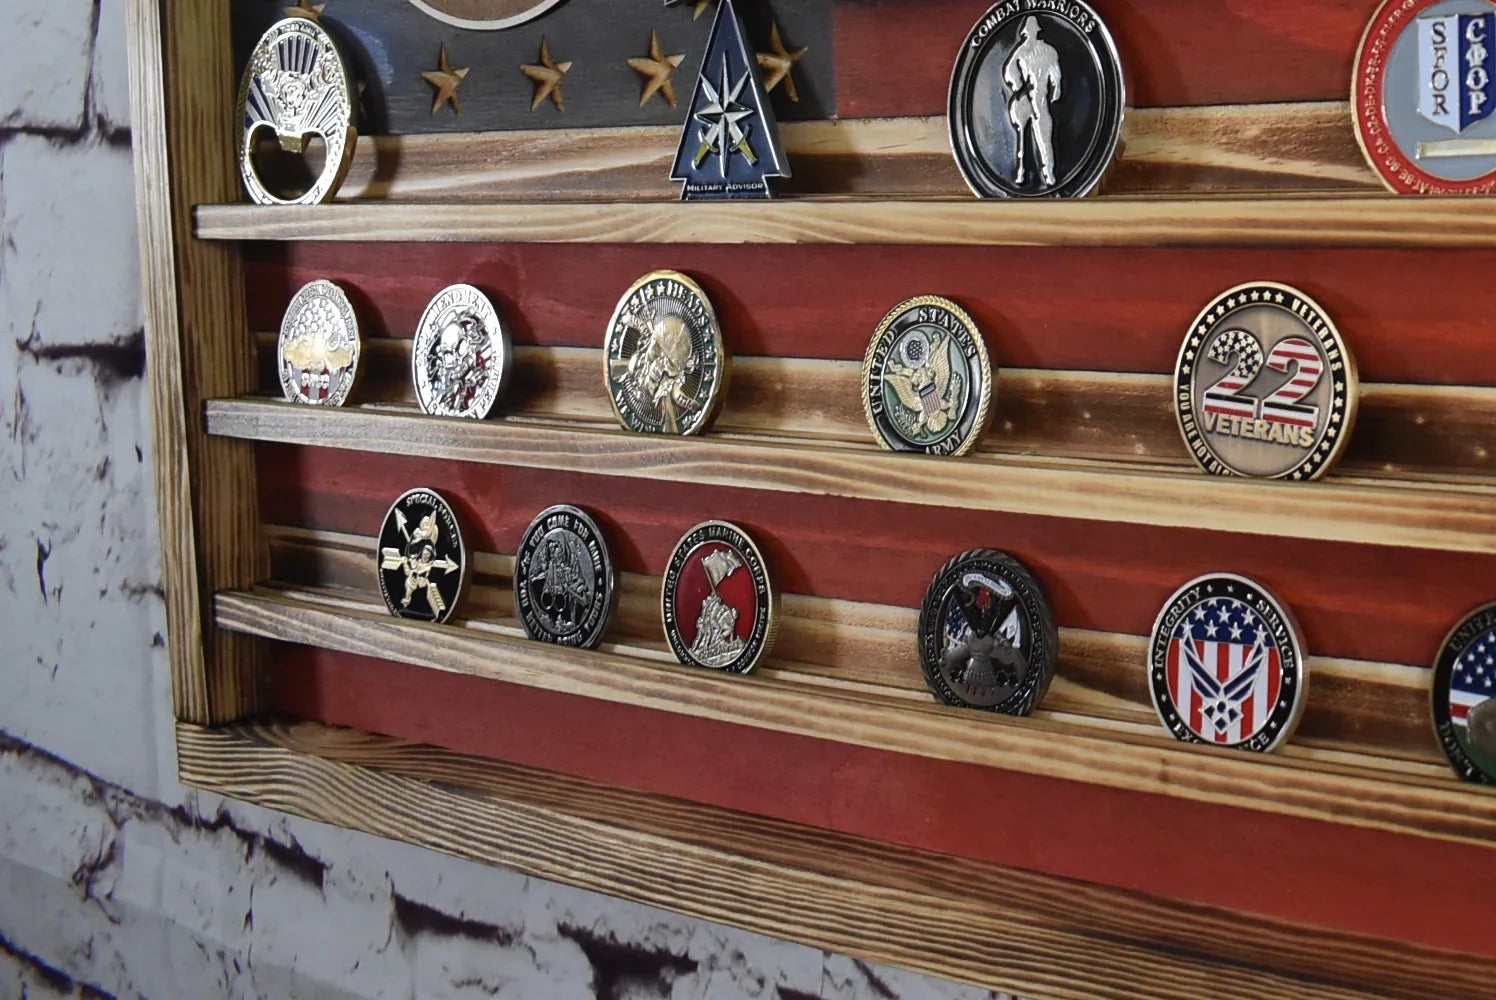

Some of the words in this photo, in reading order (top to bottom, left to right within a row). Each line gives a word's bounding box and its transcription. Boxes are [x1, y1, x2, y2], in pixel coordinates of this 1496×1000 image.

[1429, 20, 1451, 116] SFOR
[687, 182, 723, 192] MILITARY
[726, 182, 764, 192] ADVISOR
[869, 328, 897, 414] UNITED
[919, 306, 977, 357] STATES
[1291, 297, 1342, 372] VETERANS
[1179, 384, 1191, 415] YOU
[1203, 330, 1324, 430] 22
[1182, 415, 1198, 440] ARE
[1191, 438, 1212, 463] NOT
[1202, 412, 1315, 449] VETERANS
[546, 514, 570, 529] COME
[573, 518, 590, 541] FOR
[664, 570, 677, 623] UNITED
[674, 529, 705, 566] STATES
[708, 526, 745, 547] MARINE
[746, 548, 767, 595] CORPS
[1154, 586, 1201, 669] INTEGRITY
[1255, 599, 1295, 669] SERVICE
